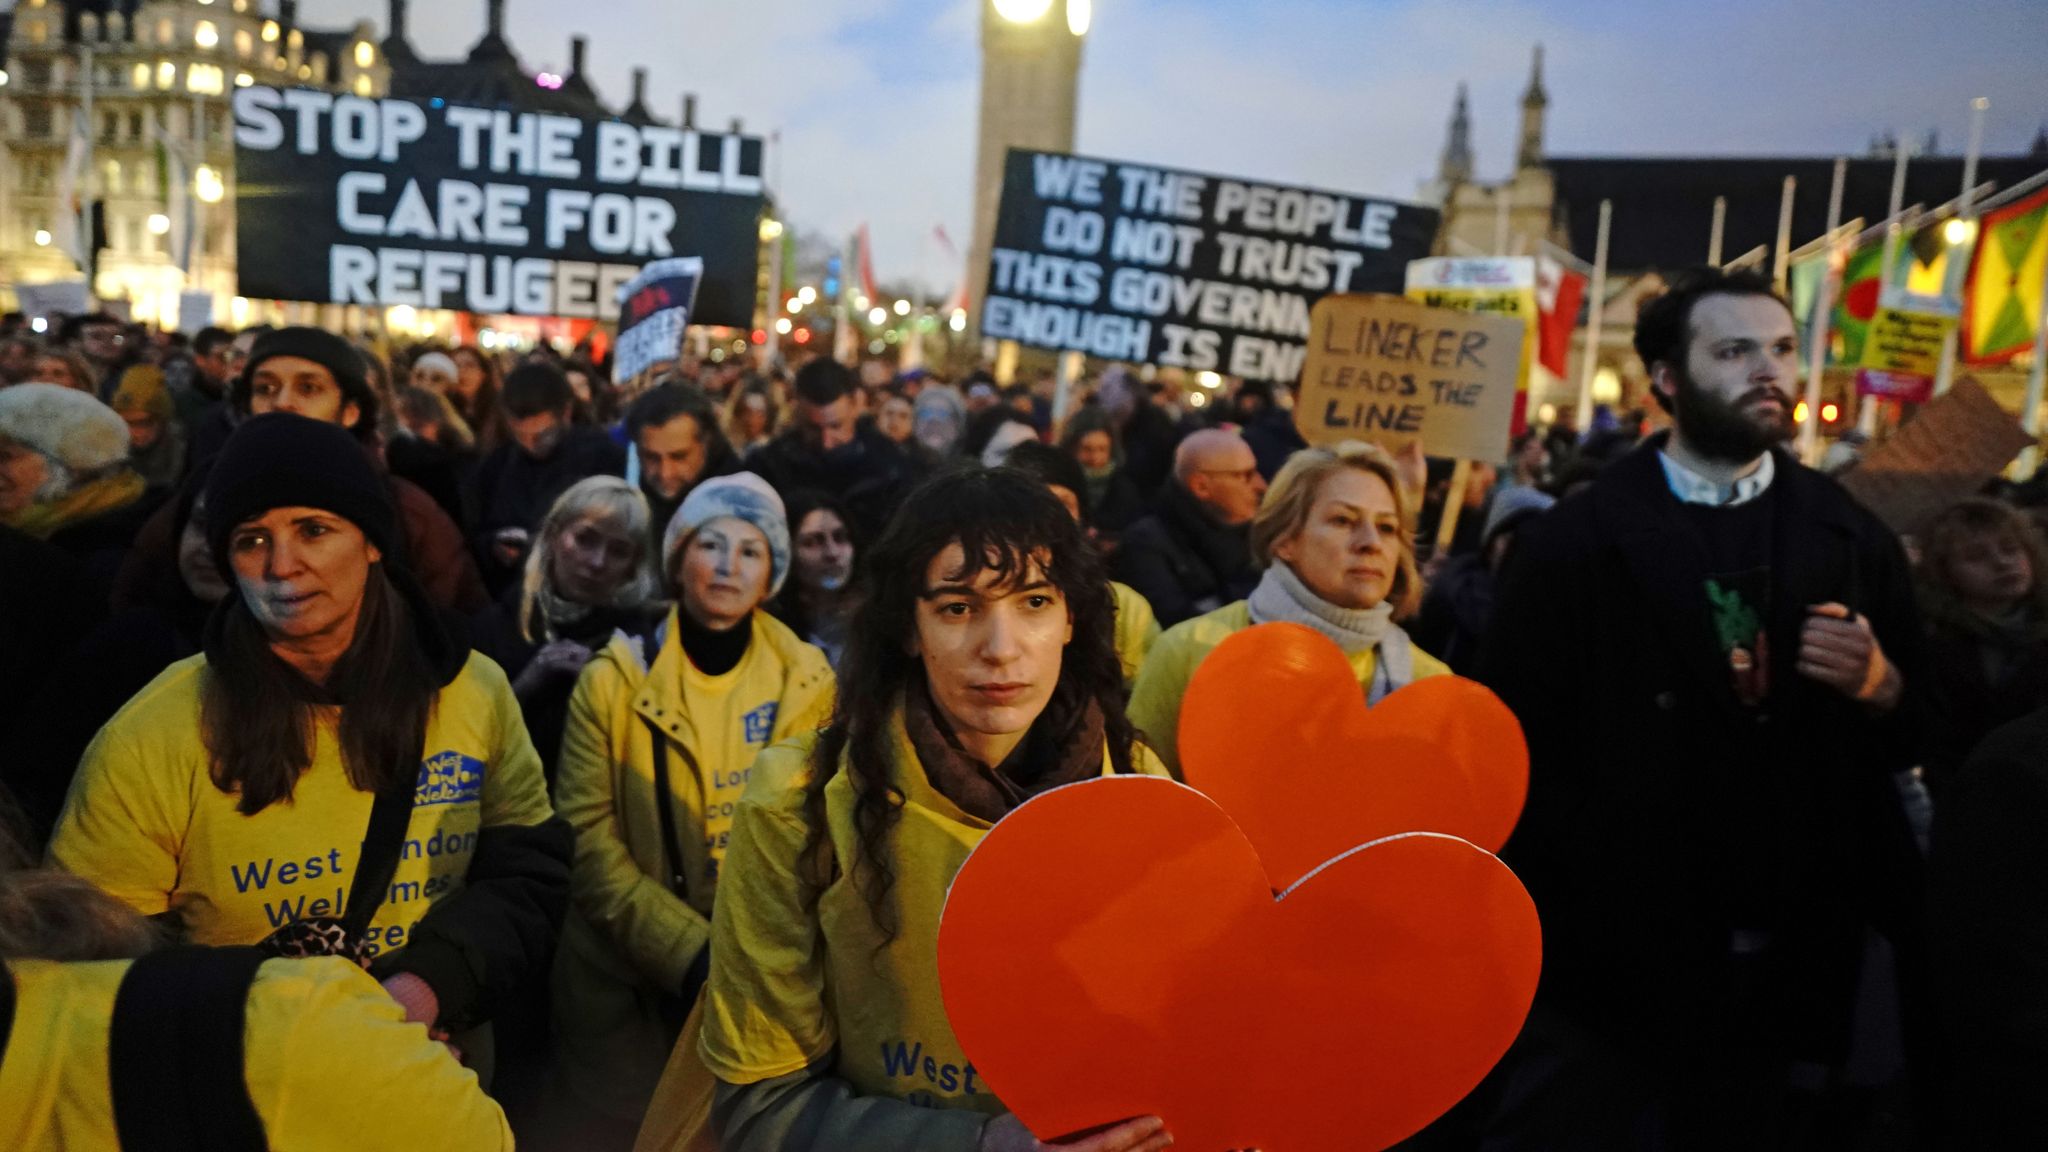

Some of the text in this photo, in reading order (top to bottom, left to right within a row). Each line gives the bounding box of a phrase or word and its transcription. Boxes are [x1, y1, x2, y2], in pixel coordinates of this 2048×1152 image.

[233, 86, 763, 195] STOP THE BILL
[337, 171, 677, 257] CARE FOR
[1033, 153, 1398, 249] WE THE PEOPLE
[992, 248, 1103, 300] THIS
[1042, 207, 1363, 295] DO NOT TRUST
[329, 243, 639, 320] REFUGEE
[984, 295, 1151, 362] ENOUGH
[1160, 323, 1222, 370] IS
[1324, 311, 1490, 369] LINEKER
[1320, 365, 1484, 407] LEADS THE
[1324, 400, 1426, 432] LINE
[231, 848, 343, 894] West
[264, 874, 451, 928] Welmes
[881, 1041, 977, 1096] West
